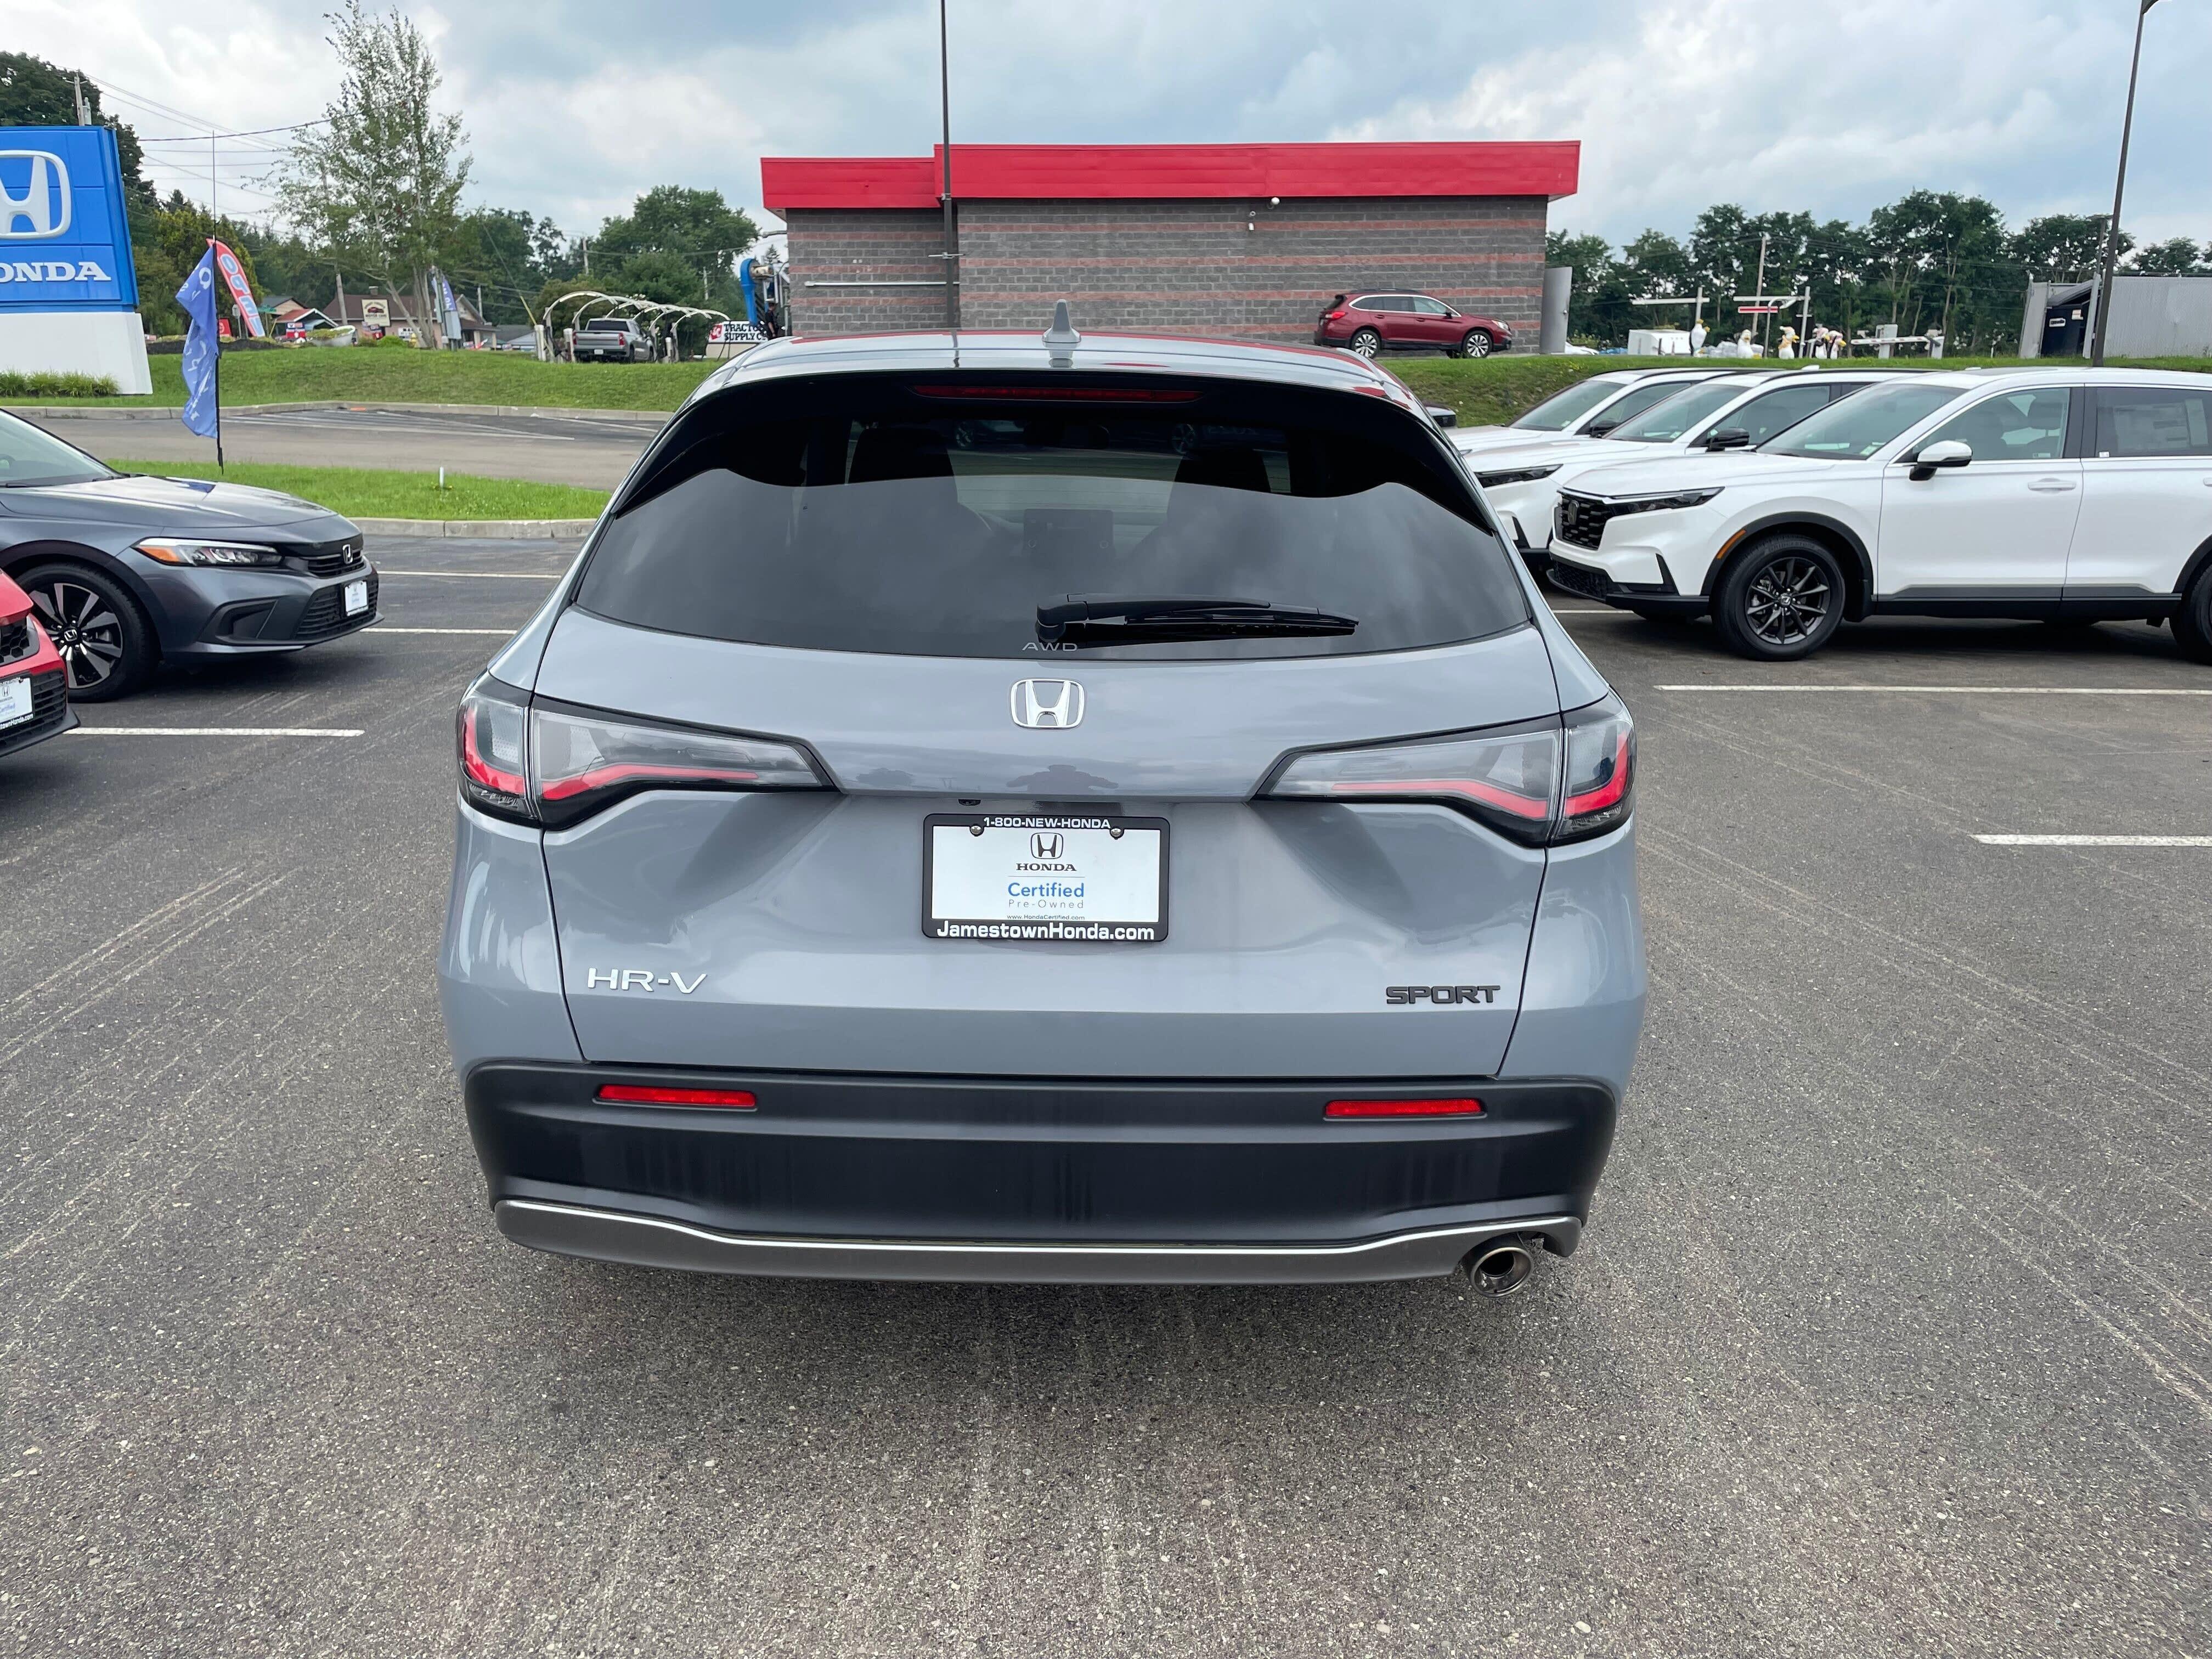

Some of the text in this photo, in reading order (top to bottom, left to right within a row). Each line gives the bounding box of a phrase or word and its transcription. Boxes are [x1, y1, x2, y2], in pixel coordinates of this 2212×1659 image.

[1022, 642, 1077, 651] AWD
[983, 817, 1111, 828] 1-800-NEW-HONDA
[1016, 863, 1077, 871] HONDA
[1008, 882, 1084, 898] Certified
[1009, 899, 1084, 909] Pre-Owned
[936, 920, 1154, 940] JamestownHonda.com
[587, 967, 708, 994] HR-V
[1386, 985, 1501, 1004] SPORT
